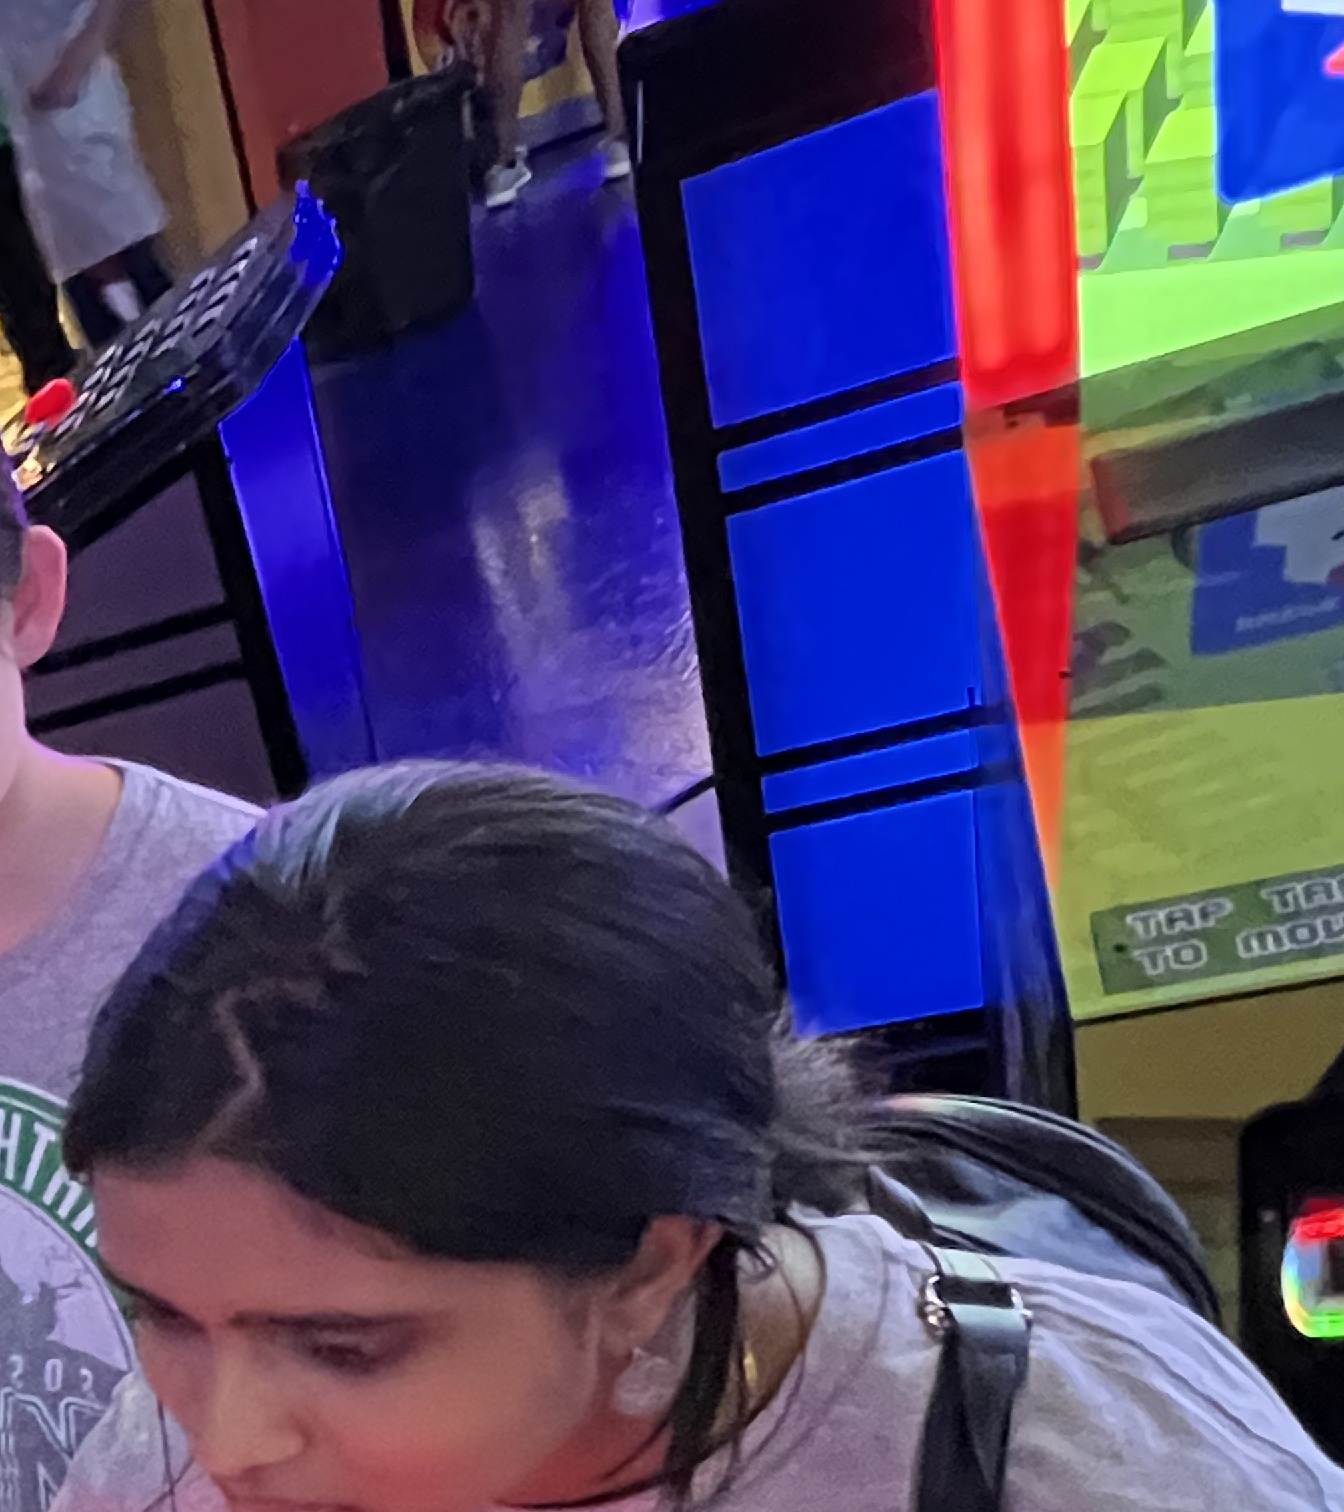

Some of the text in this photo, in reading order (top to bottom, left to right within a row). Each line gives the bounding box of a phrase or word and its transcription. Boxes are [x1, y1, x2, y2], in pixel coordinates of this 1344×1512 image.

[1126, 873, 1344, 940] TAP TA
[1133, 938, 1208, 976] TO
